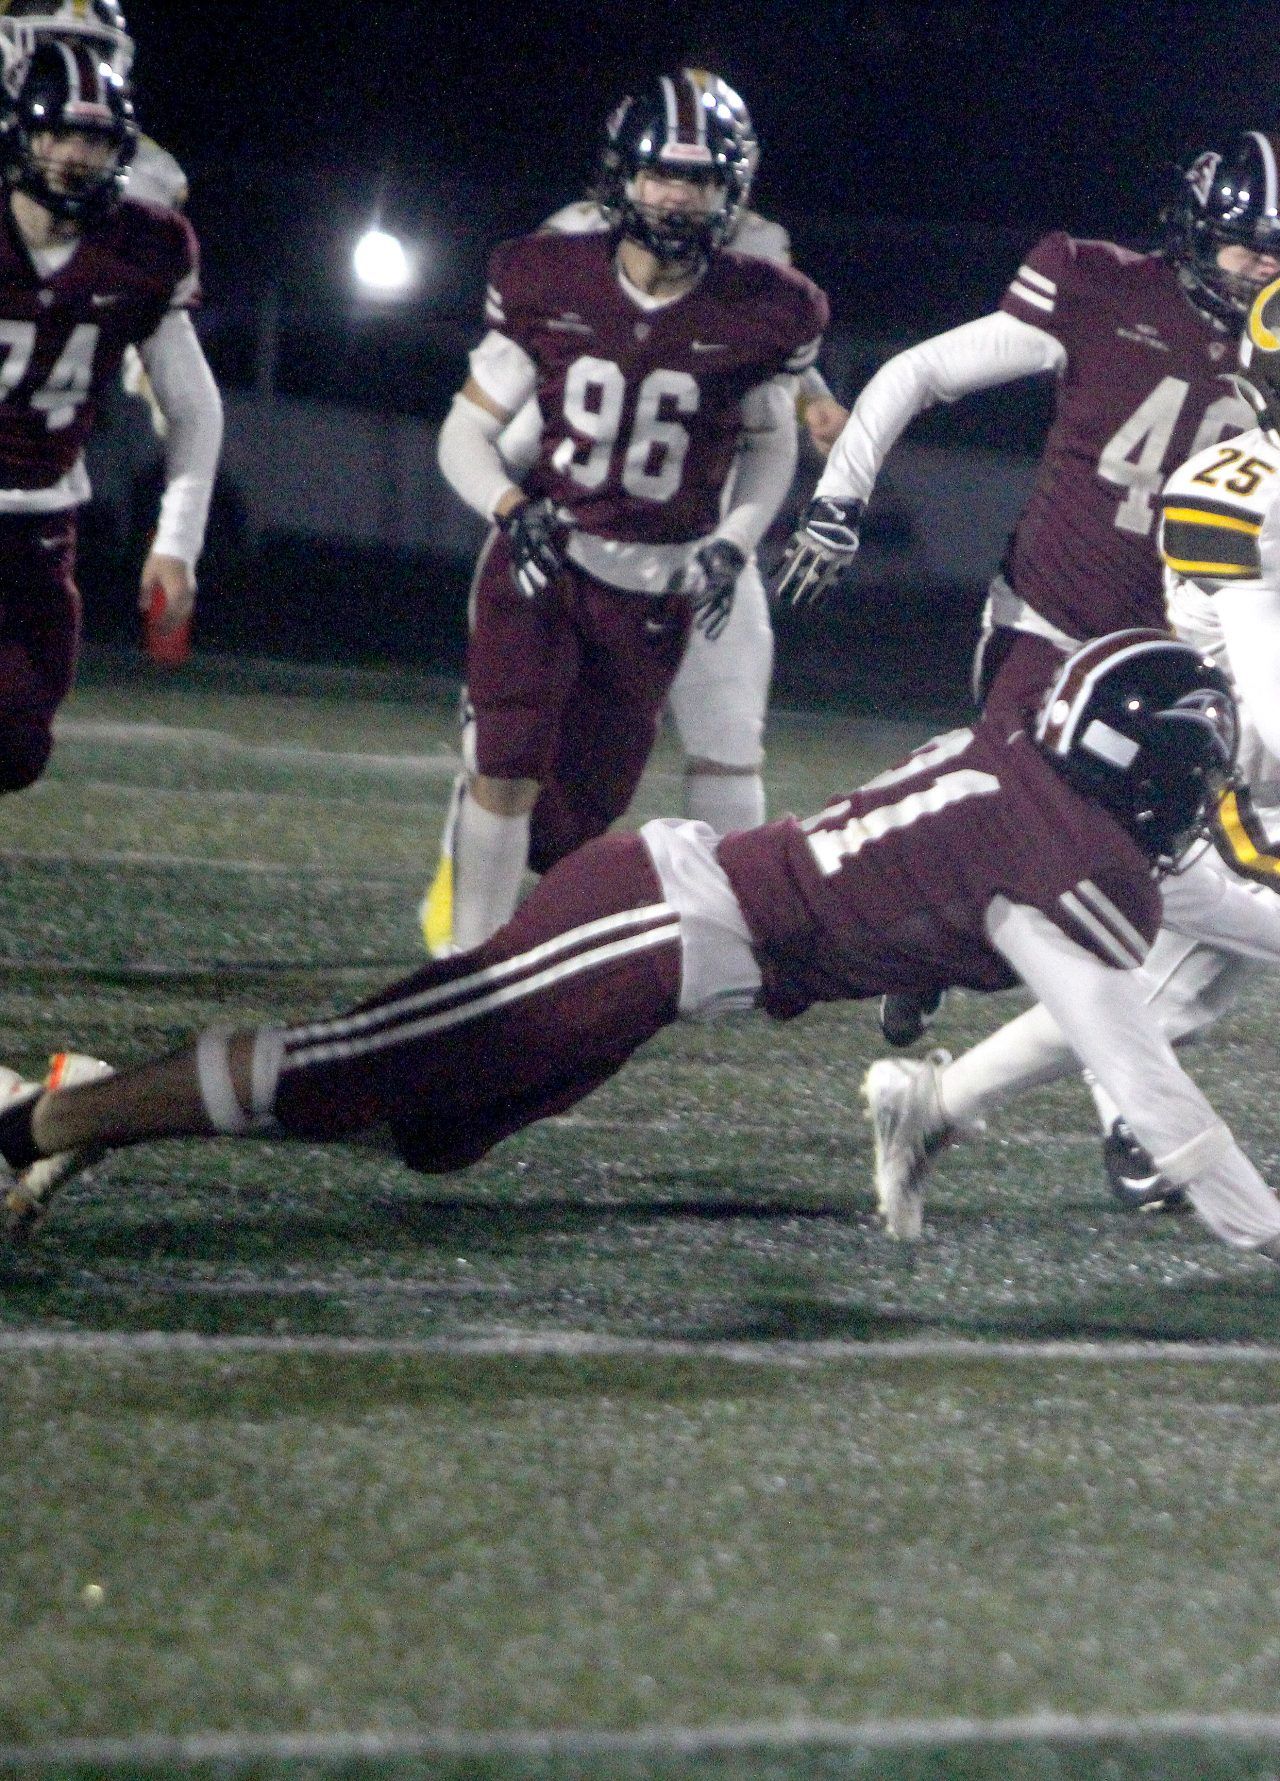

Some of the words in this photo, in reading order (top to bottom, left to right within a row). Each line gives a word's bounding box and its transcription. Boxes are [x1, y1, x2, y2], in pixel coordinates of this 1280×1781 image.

[0, 319, 99, 429] 74
[552, 355, 700, 501] 96
[1098, 376, 1260, 535] 4
[1190, 447, 1278, 497] 25
